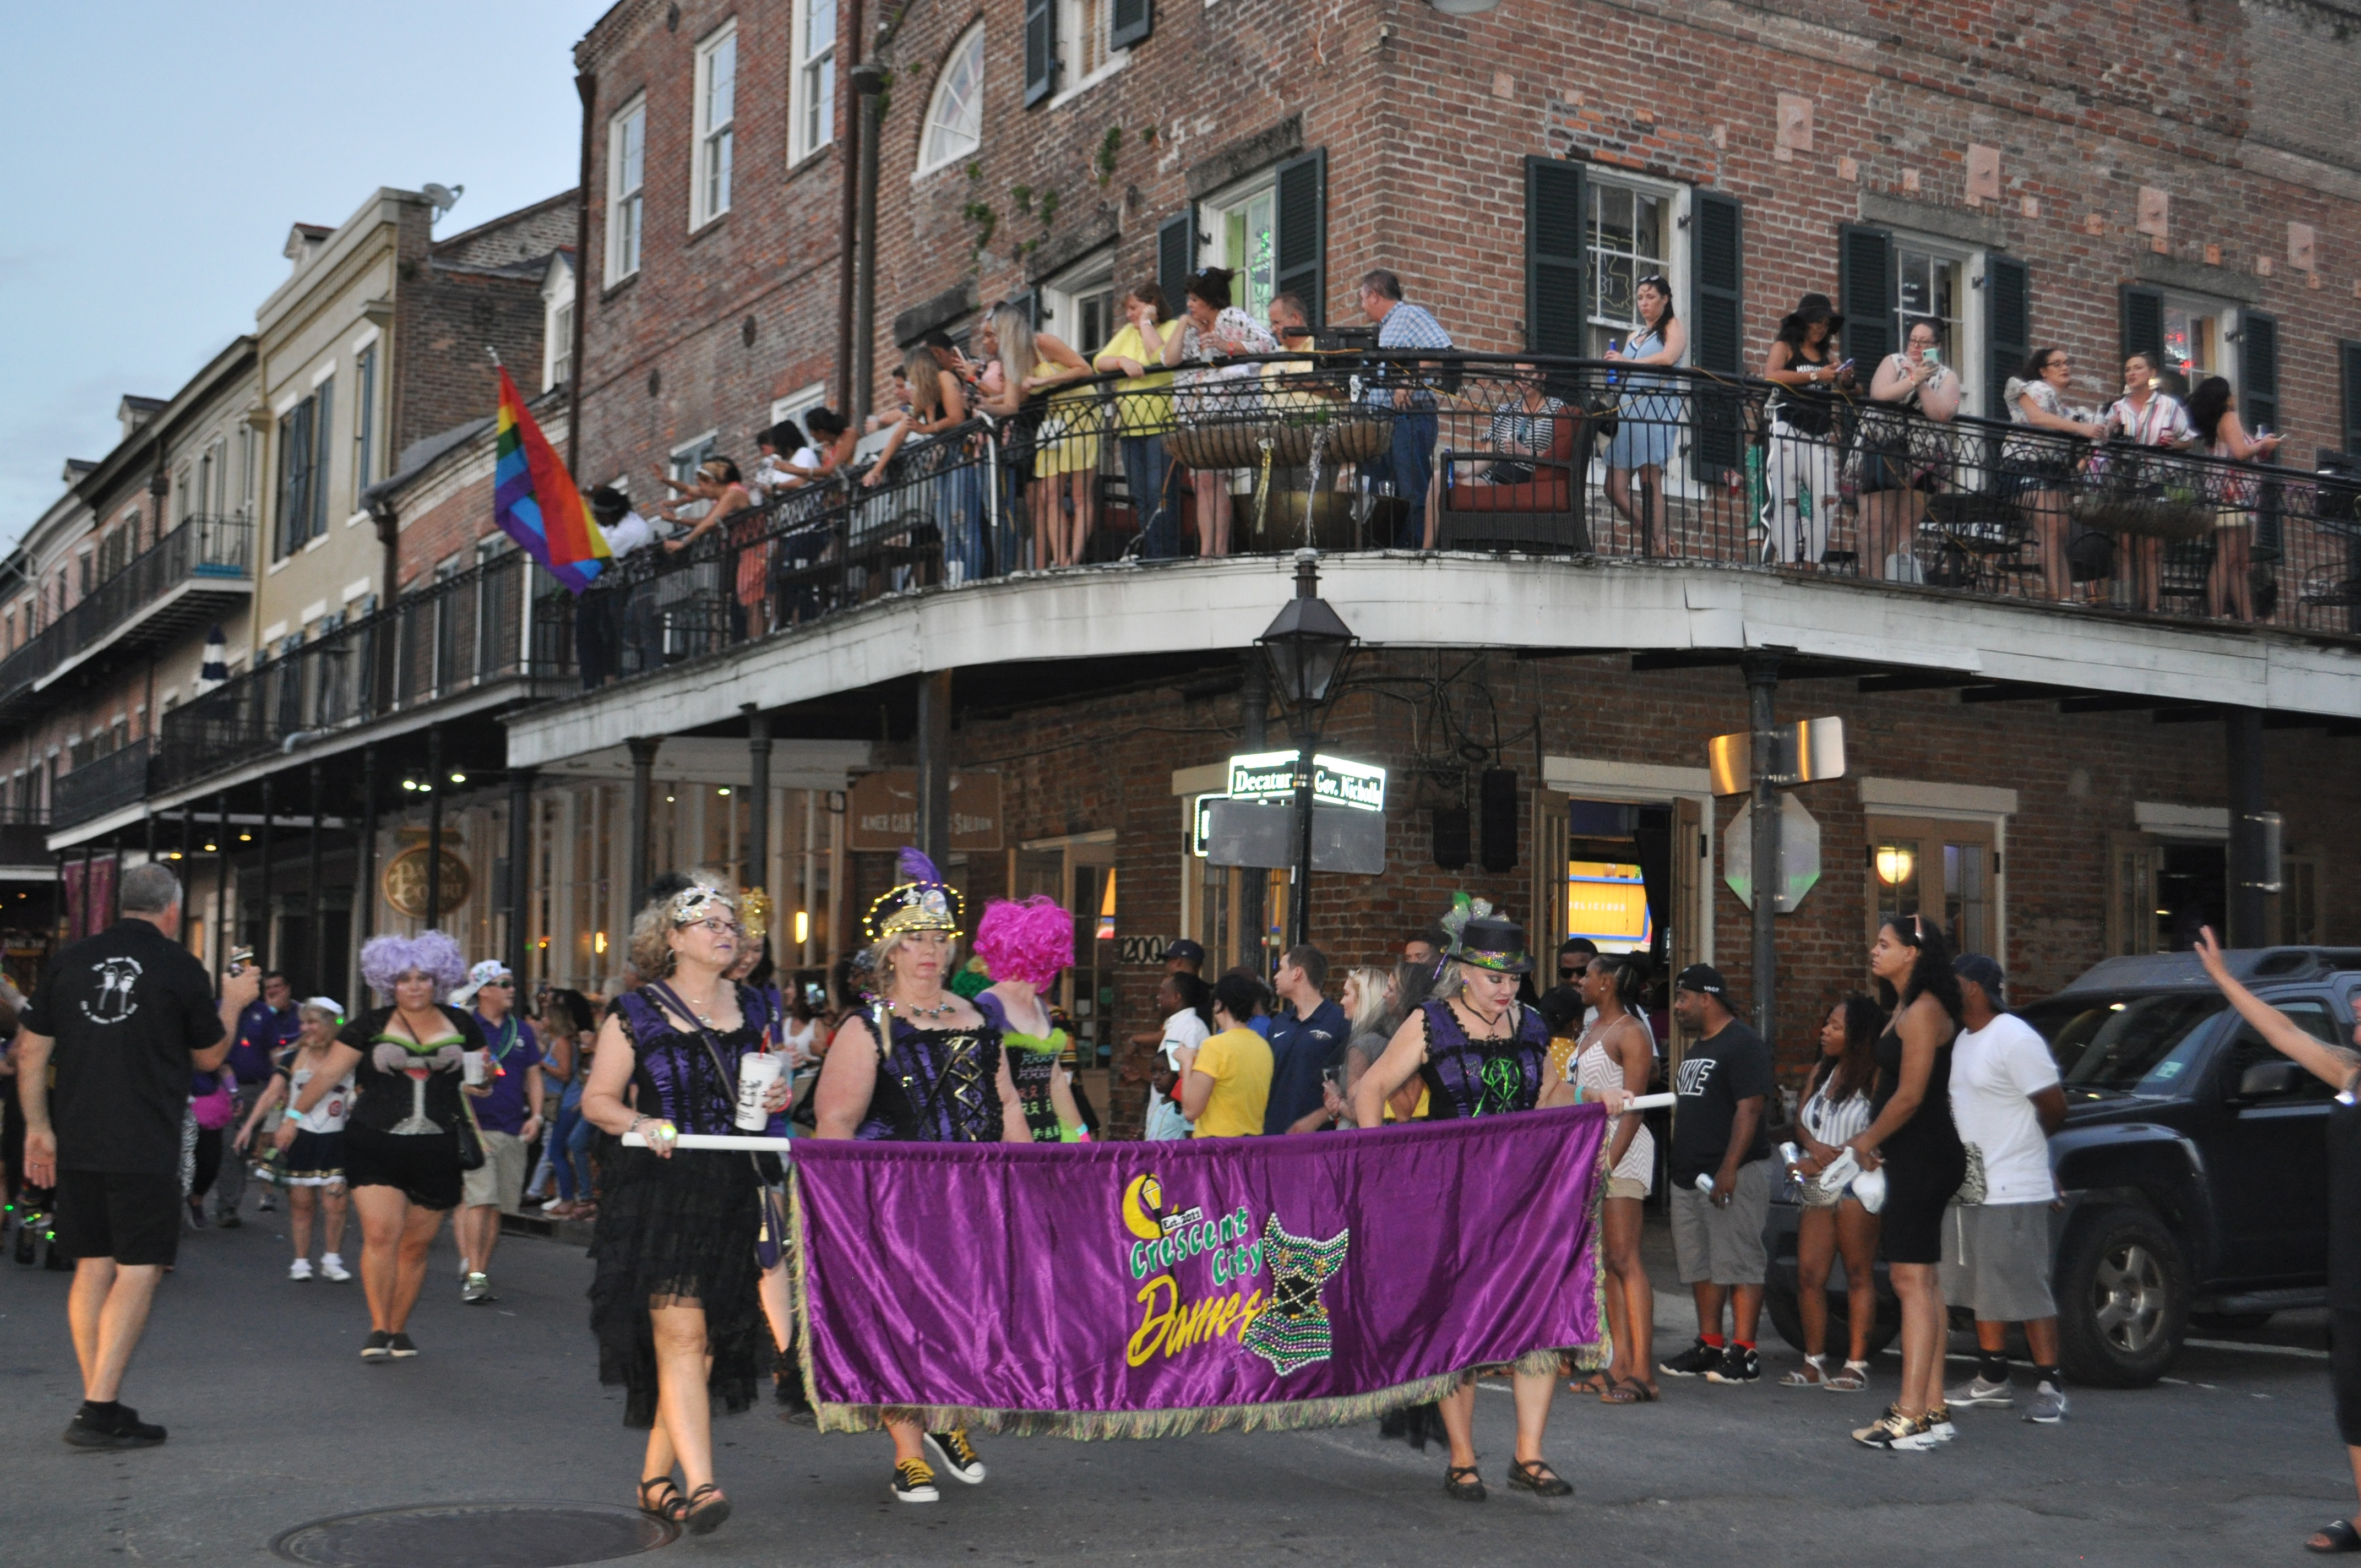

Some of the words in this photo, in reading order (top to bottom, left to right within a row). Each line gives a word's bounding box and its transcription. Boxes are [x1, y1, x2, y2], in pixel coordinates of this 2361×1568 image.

[1234, 770, 1293, 792] Decatur
[1314, 770, 1339, 796] Gov.
[1569, 901, 1626, 912] DELICIOUS
[1130, 1207, 1249, 1279] Crescent
[1212, 1238, 1265, 1286] City
[1127, 1274, 1267, 1366] Dames
